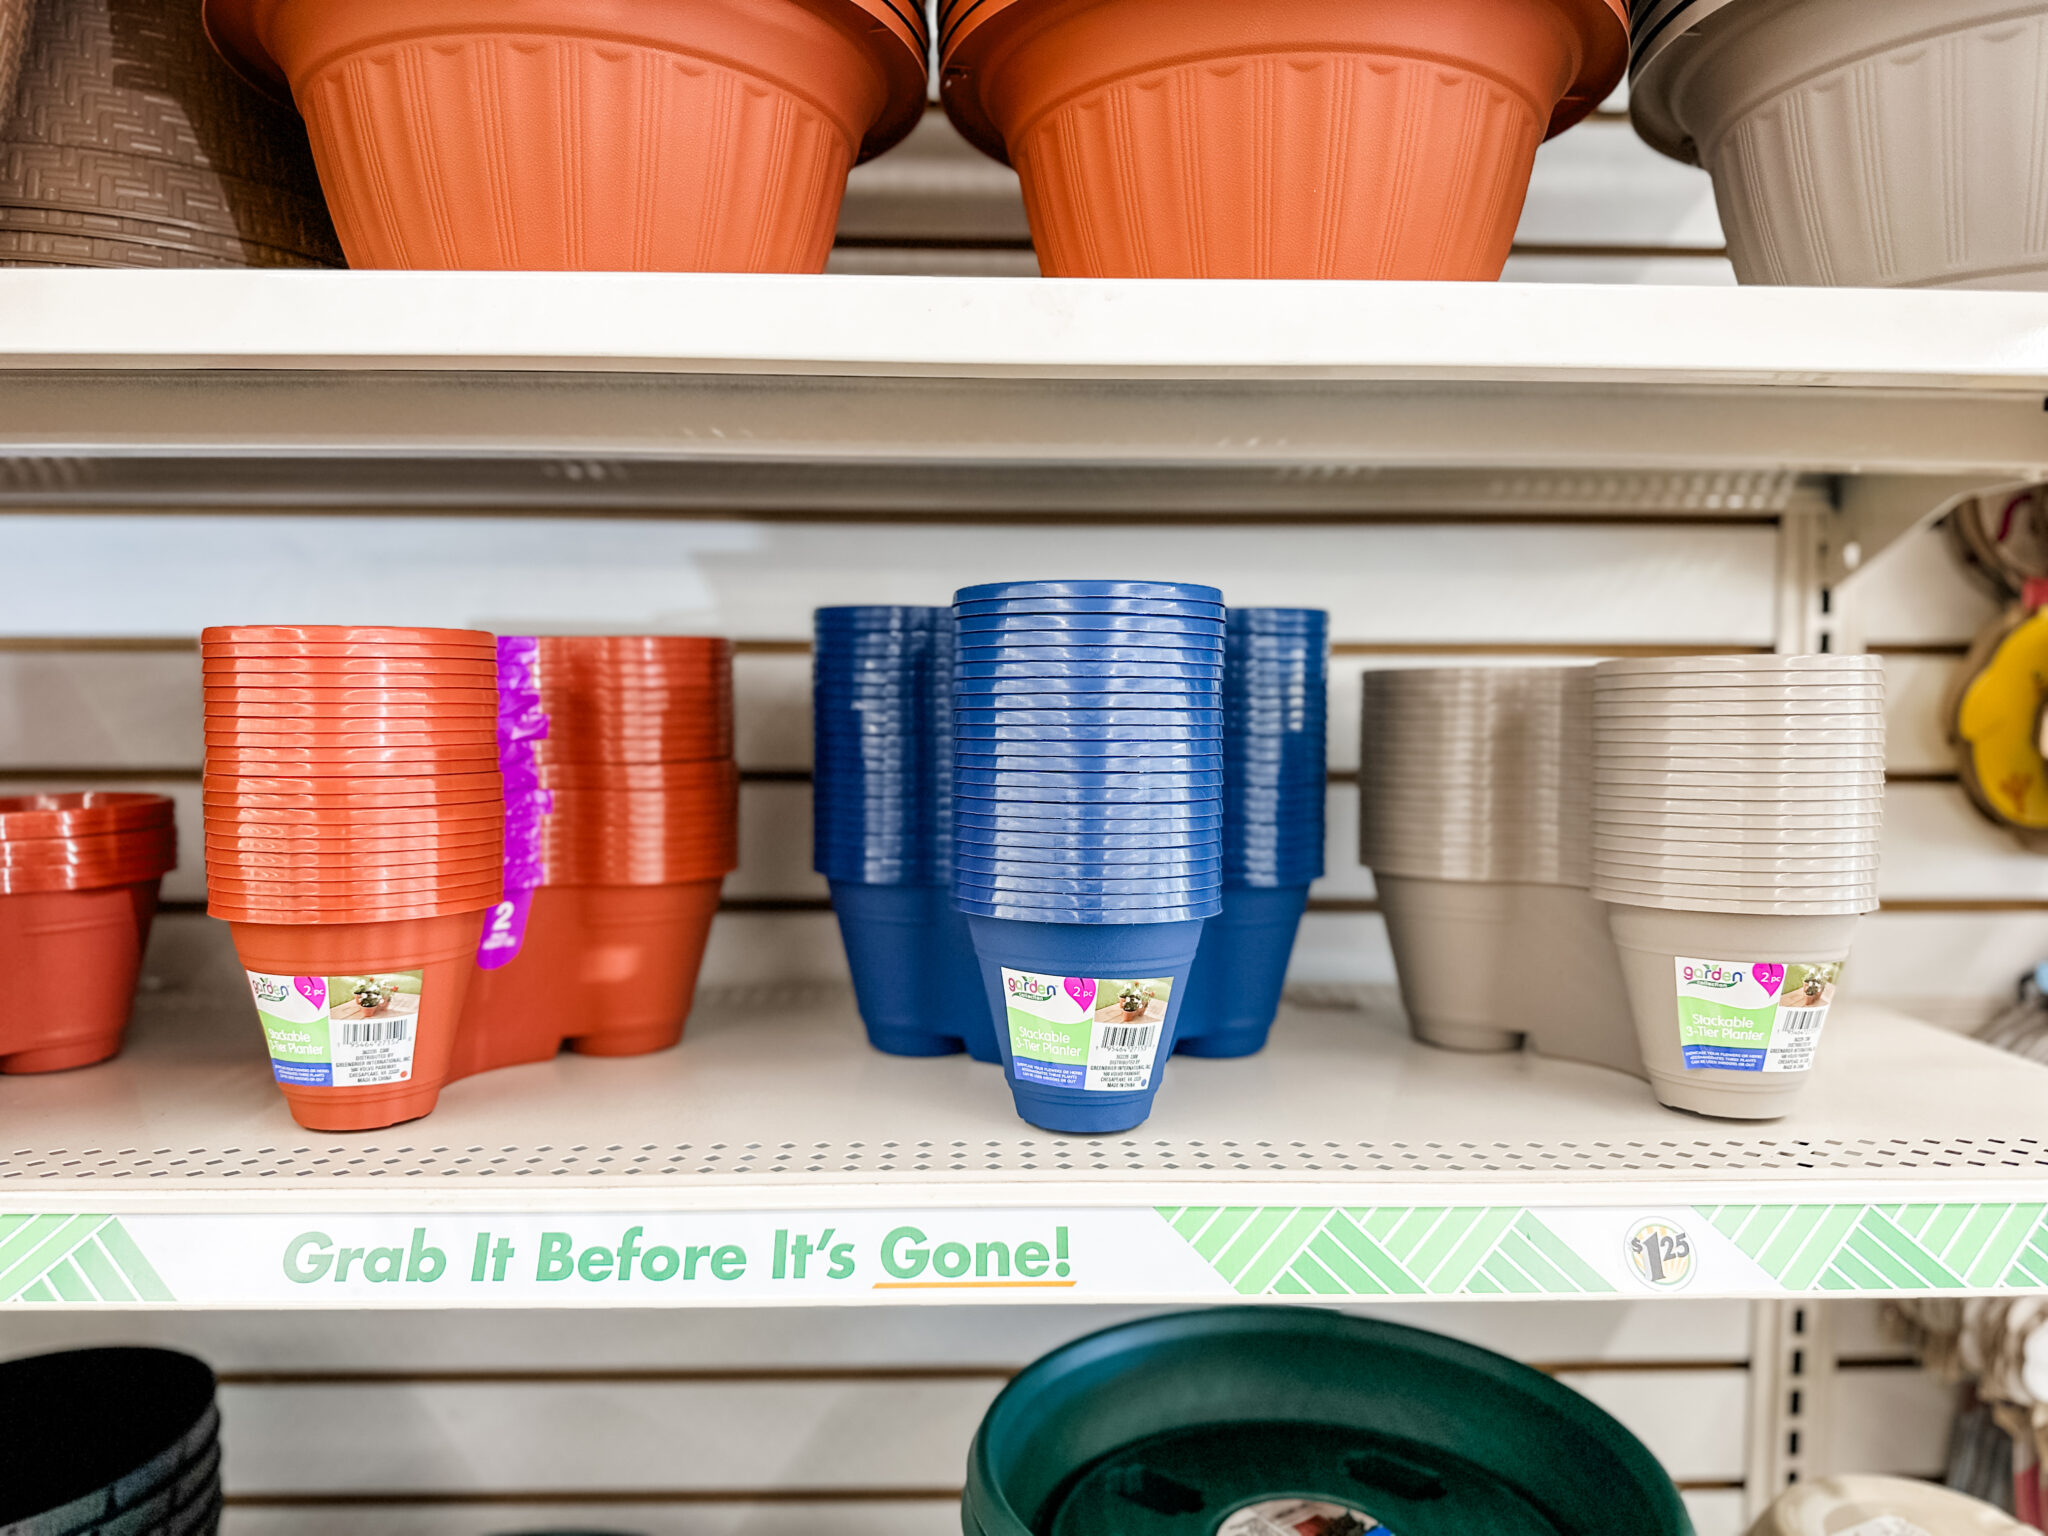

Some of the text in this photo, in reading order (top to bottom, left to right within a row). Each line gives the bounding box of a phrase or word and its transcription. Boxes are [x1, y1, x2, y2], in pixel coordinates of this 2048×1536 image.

[492, 901, 515, 931] 2
[1683, 966, 1743, 982] garden
[1760, 972, 1769, 983] 2
[252, 979, 290, 996] garden
[303, 985, 325, 997] 2 pc
[1008, 977, 1057, 996] garden
[1072, 986, 1093, 998] 2 pc
[1692, 1013, 1754, 1028] Stackable
[1018, 1026, 1070, 1043] Stackable
[1686, 1025, 1765, 1040] 3-Tier Planter
[287, 1042, 324, 1055] Planter
[1015, 1037, 1082, 1056] 3-Tier Planter
[283, 1225, 1071, 1284] Grab It Before It's Gone!
